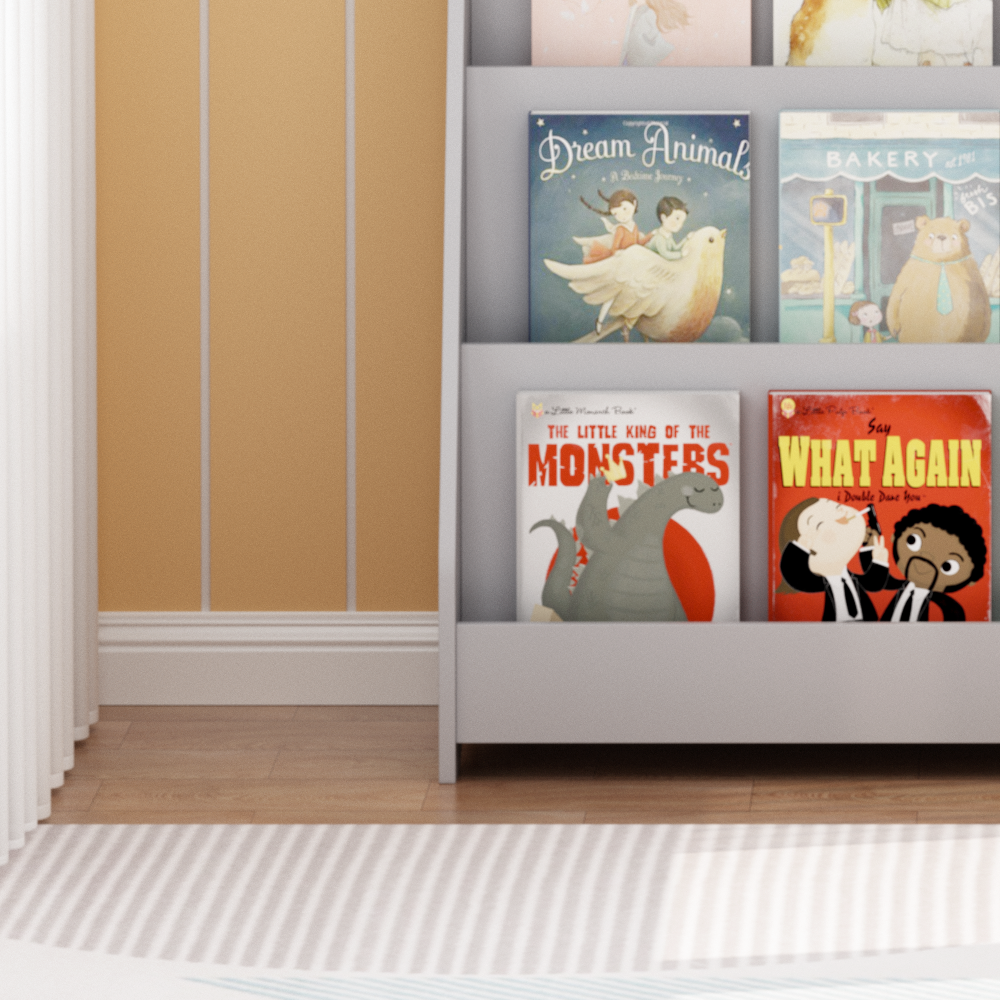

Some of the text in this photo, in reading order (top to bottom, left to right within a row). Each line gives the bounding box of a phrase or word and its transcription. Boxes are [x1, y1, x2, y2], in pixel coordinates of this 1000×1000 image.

[538, 121, 750, 182] Dream Animals
[826, 150, 938, 168] BAKERY
[547, 424, 711, 439] THE LITTLE KING OF THE
[867, 417, 892, 436] Say
[527, 442, 730, 487] MONSTERS
[778, 435, 983, 489] WHAT AGAIN
